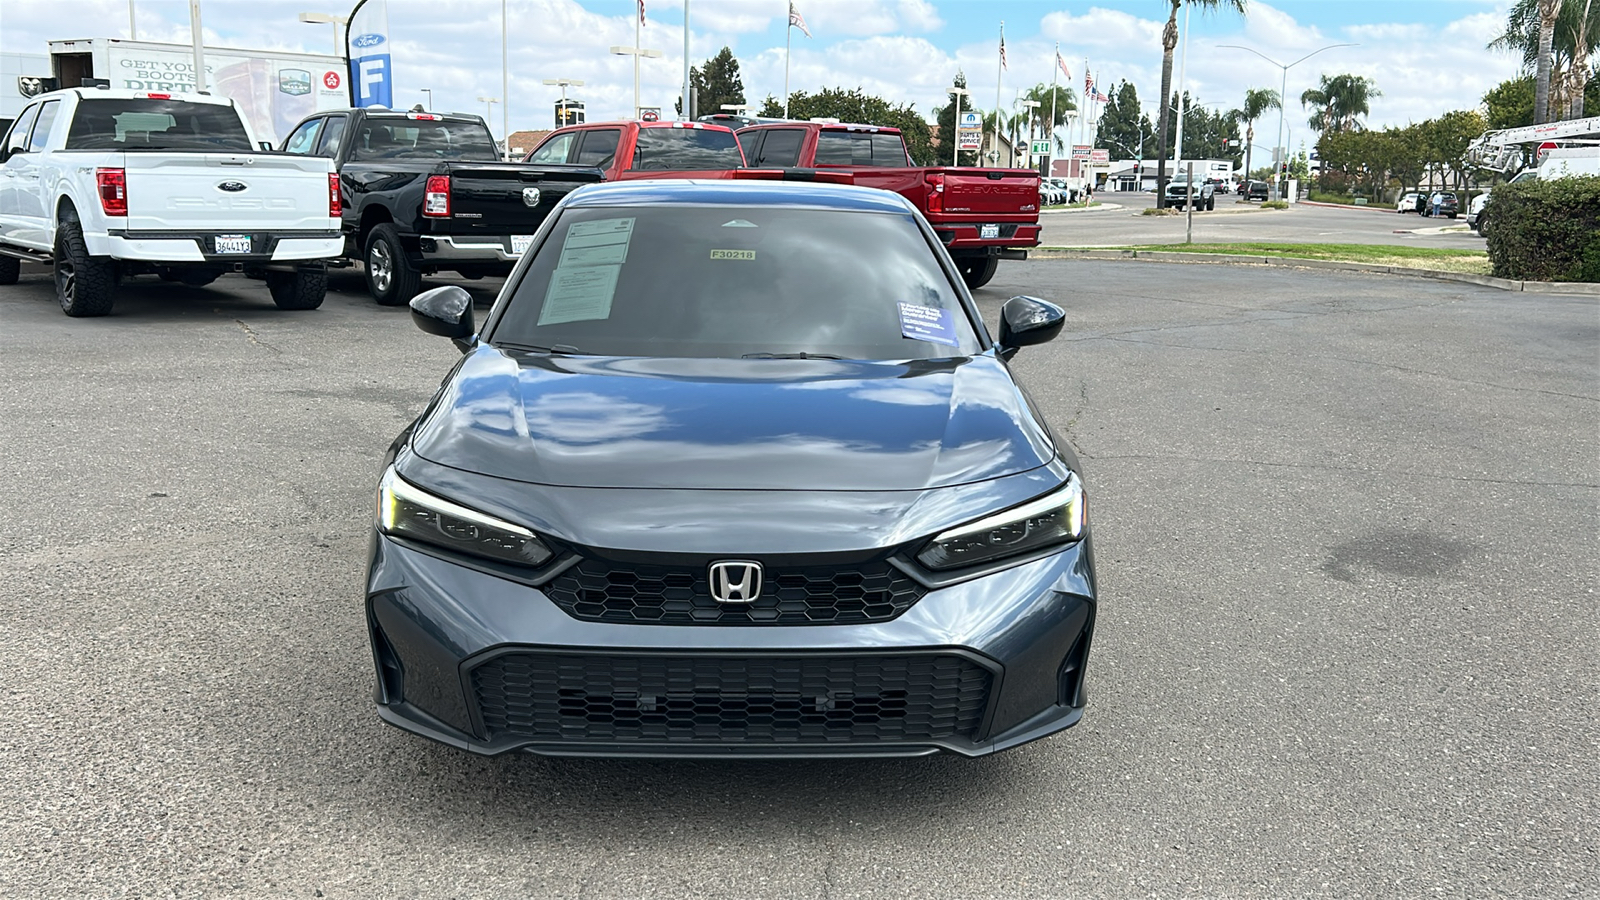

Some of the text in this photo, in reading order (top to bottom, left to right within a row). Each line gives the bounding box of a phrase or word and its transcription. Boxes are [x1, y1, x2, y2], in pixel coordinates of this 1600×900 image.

[357, 35, 379, 46] Ford
[120, 59, 158, 69] GET
[136, 70, 197, 82] BOOTS
[360, 59, 385, 99] F
[952, 186, 1033, 195] CHEVROLET
[166, 196, 297, 210] F-150
[216, 241, 251, 253] 36441Y3
[712, 250, 753, 259] F30218
